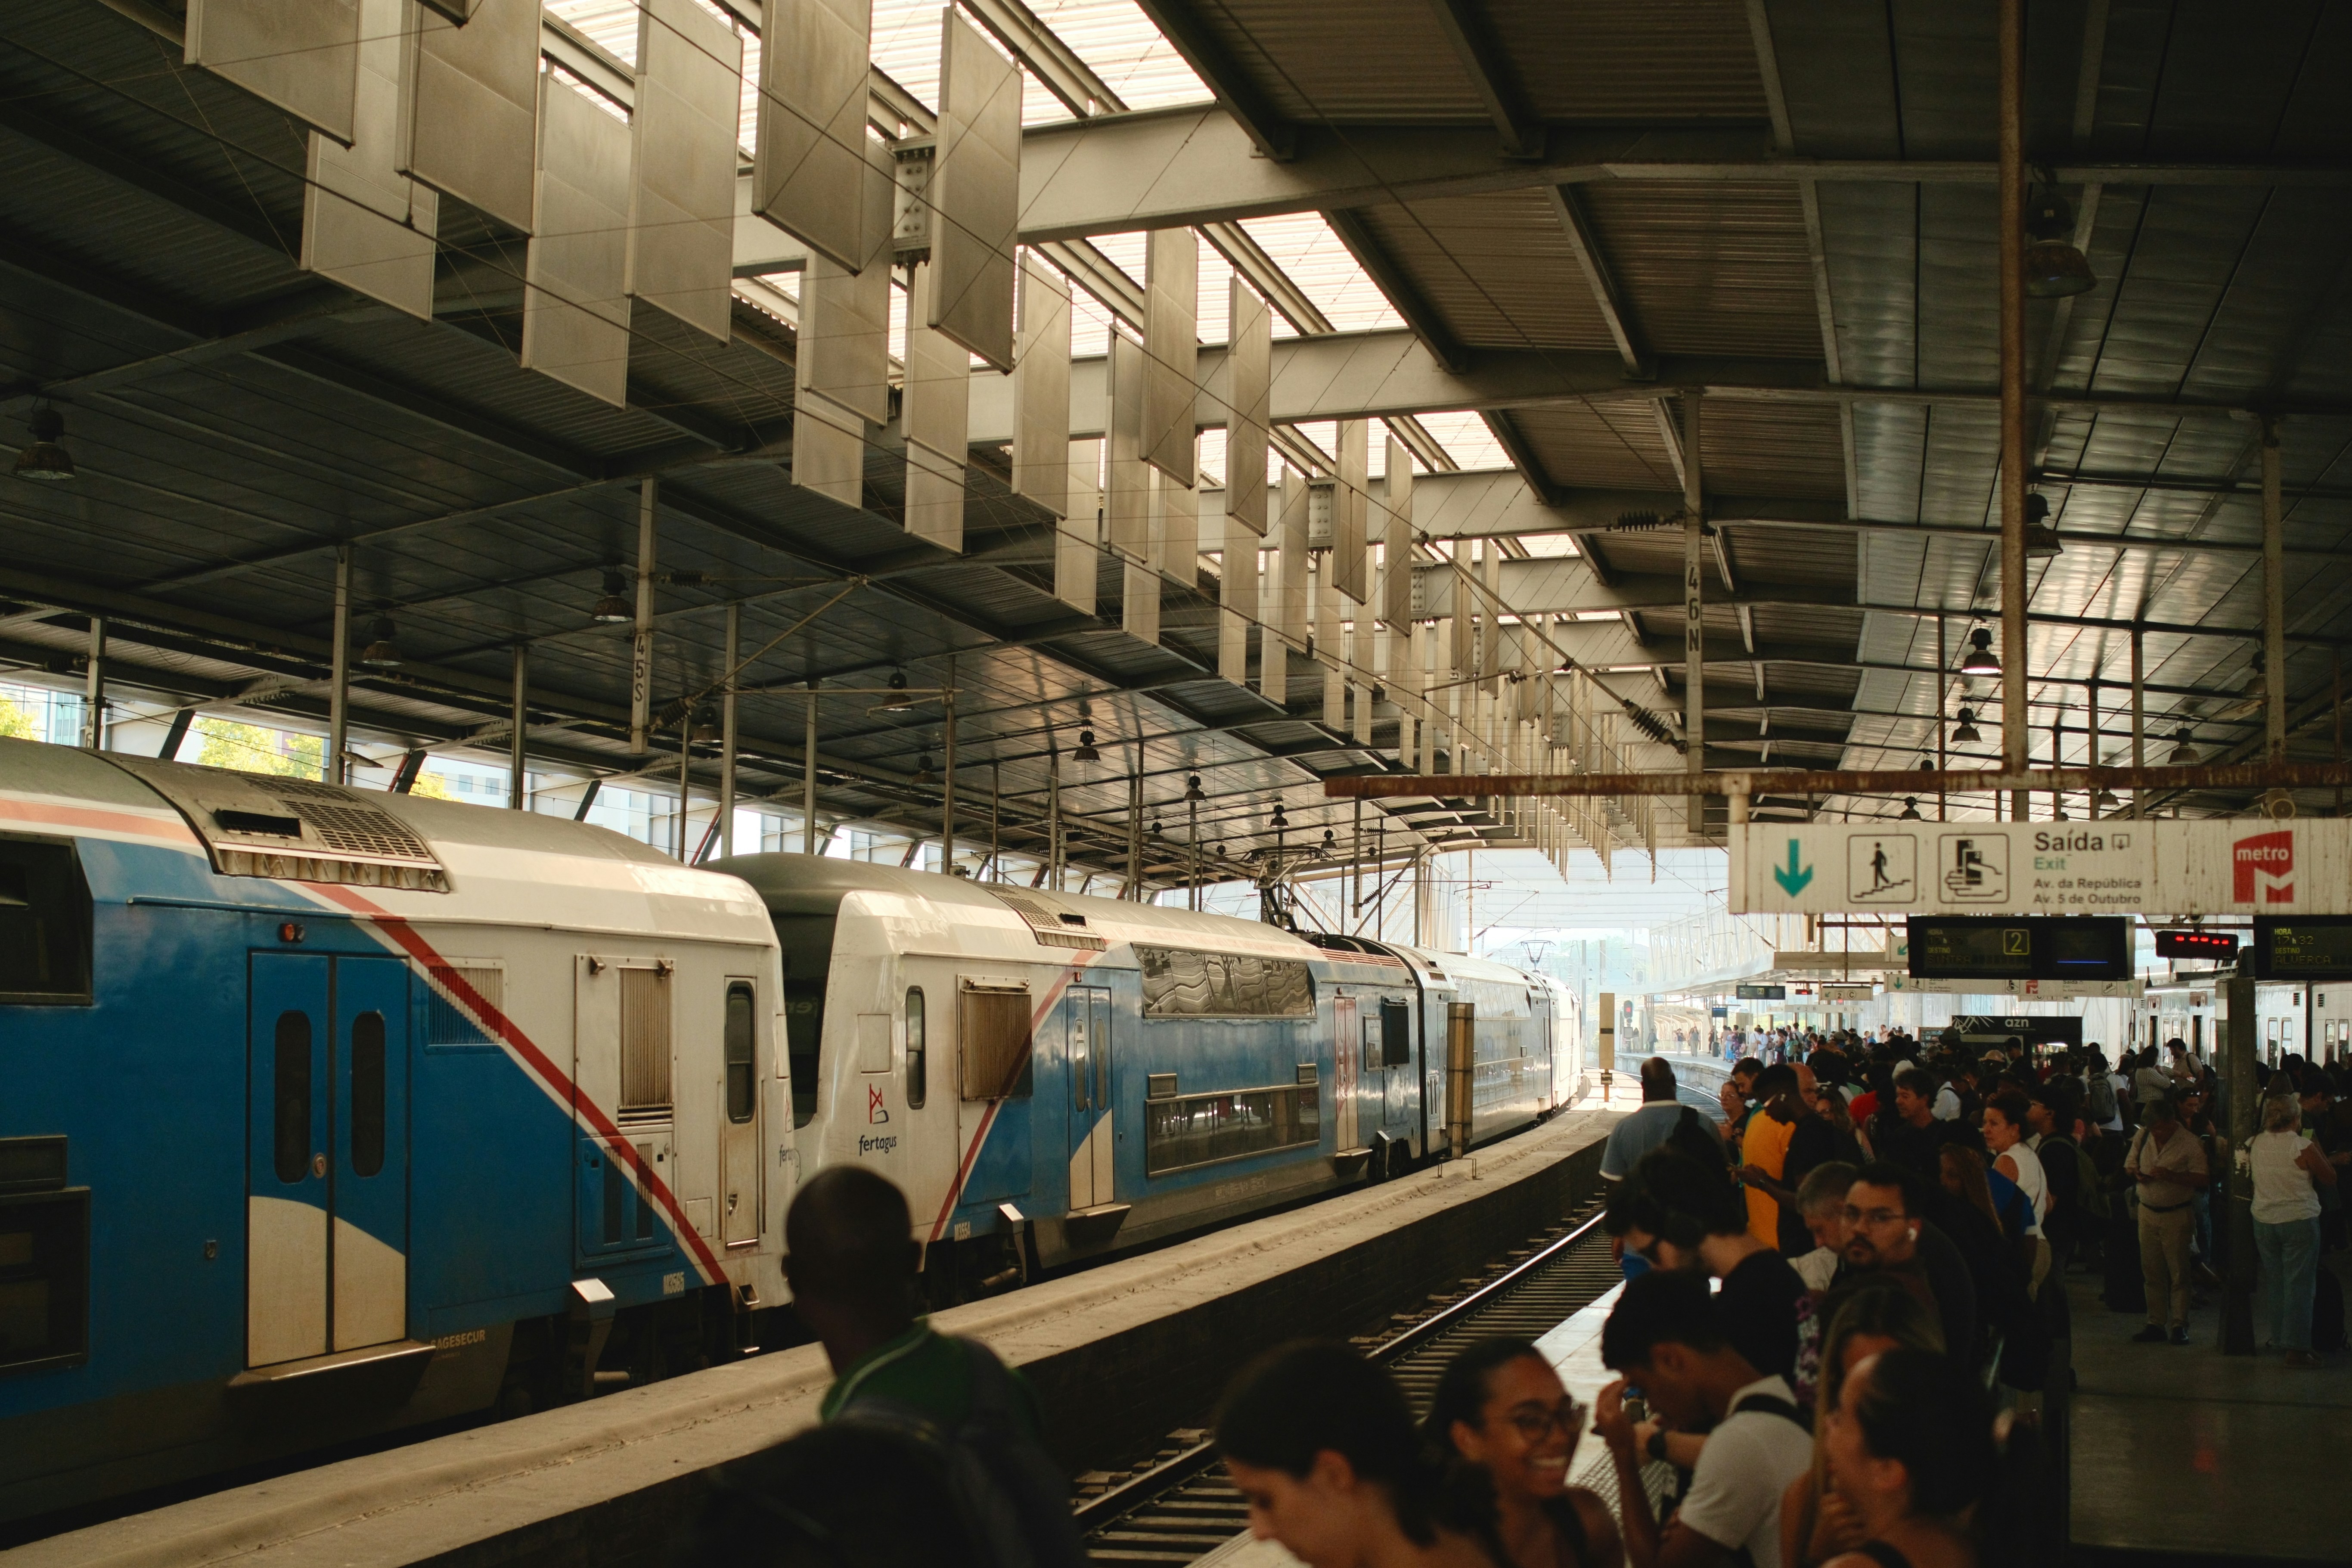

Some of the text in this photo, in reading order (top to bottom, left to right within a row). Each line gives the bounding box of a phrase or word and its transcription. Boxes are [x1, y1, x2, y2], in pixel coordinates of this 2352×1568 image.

[1687, 567, 1700, 652] 46N
[634, 634, 645, 702] 45S
[2035, 829, 2104, 851] Saída
[2236, 845, 2289, 861] metro
[2034, 857, 2066, 870] Exit
[2033, 879, 2141, 890] Av. da República
[2033, 894, 2141, 904] Av. 5 de Outubro
[2010, 932, 2023, 952] 2
[2299, 936, 2314, 945] 32
[2005, 1019, 2029, 1028] azn
[859, 1135, 897, 1156] fertagus
